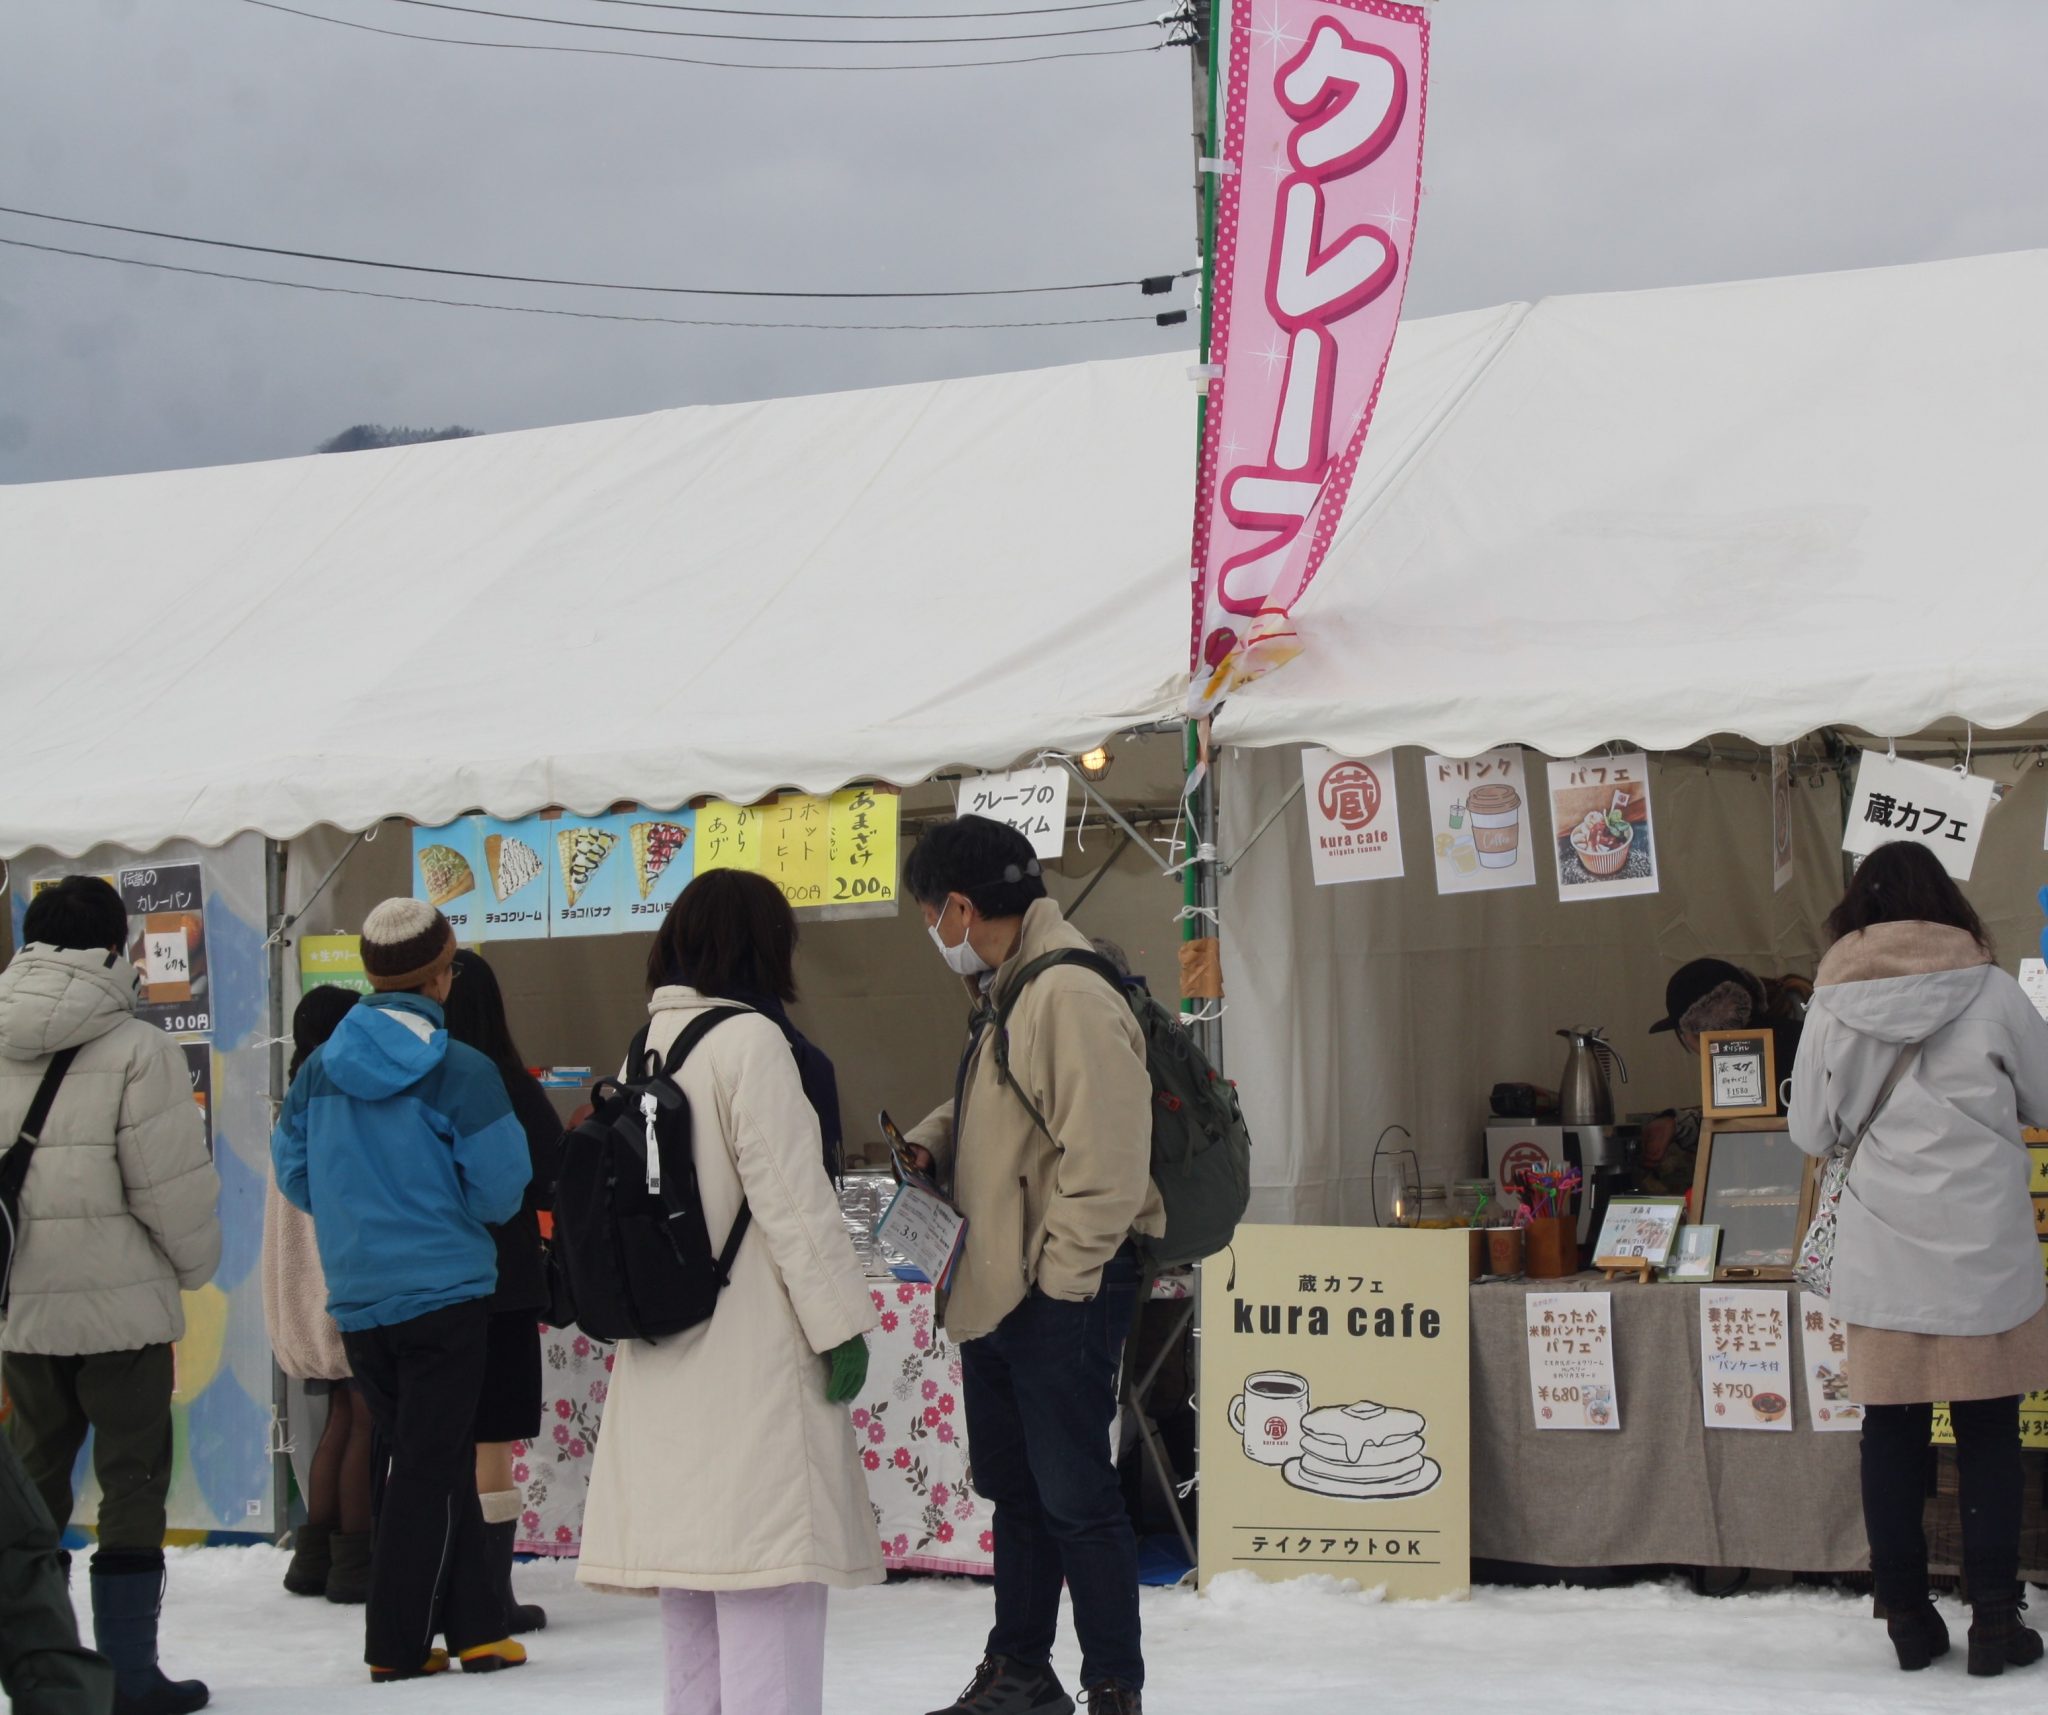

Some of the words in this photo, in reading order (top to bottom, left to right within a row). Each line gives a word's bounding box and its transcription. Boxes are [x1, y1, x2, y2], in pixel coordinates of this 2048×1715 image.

[1439, 758, 1511, 781] ドリンク
[1570, 767, 1629, 784] パフェ
[973, 785, 1054, 812] クレープの
[1864, 793, 1968, 842] 蔵カフェ
[738, 809, 755, 852] から
[800, 803, 819, 861] ホット
[849, 791, 877, 867] あまざけ
[708, 817, 728, 861] あげ
[777, 808, 793, 872] コーヒー
[1320, 835, 1352, 849] kura
[1356, 830, 1388, 845] cafe
[123, 870, 158, 887] 伝説の
[833, 877, 892, 899] 200円
[137, 892, 192, 912] カレーパン
[486, 911, 542, 923] チョコクリーム
[561, 906, 612, 919] チョコバナナ
[164, 1014, 209, 1030] 300円
[1298, 1275, 1384, 1293] 蔵カフェ
[1234, 1298, 1329, 1336] kura
[1347, 1303, 1441, 1339] cafe
[1544, 1309, 1598, 1324] あったか
[1546, 1339, 1591, 1354] パフェ
[1715, 1336, 1777, 1352] シチュー
[1719, 1360, 1779, 1372] パンケーキ付
[1538, 1386, 1579, 1402] ¥680
[1712, 1382, 1753, 1399] ¥750
[1252, 1536, 1420, 1555] テイクアウトOK
